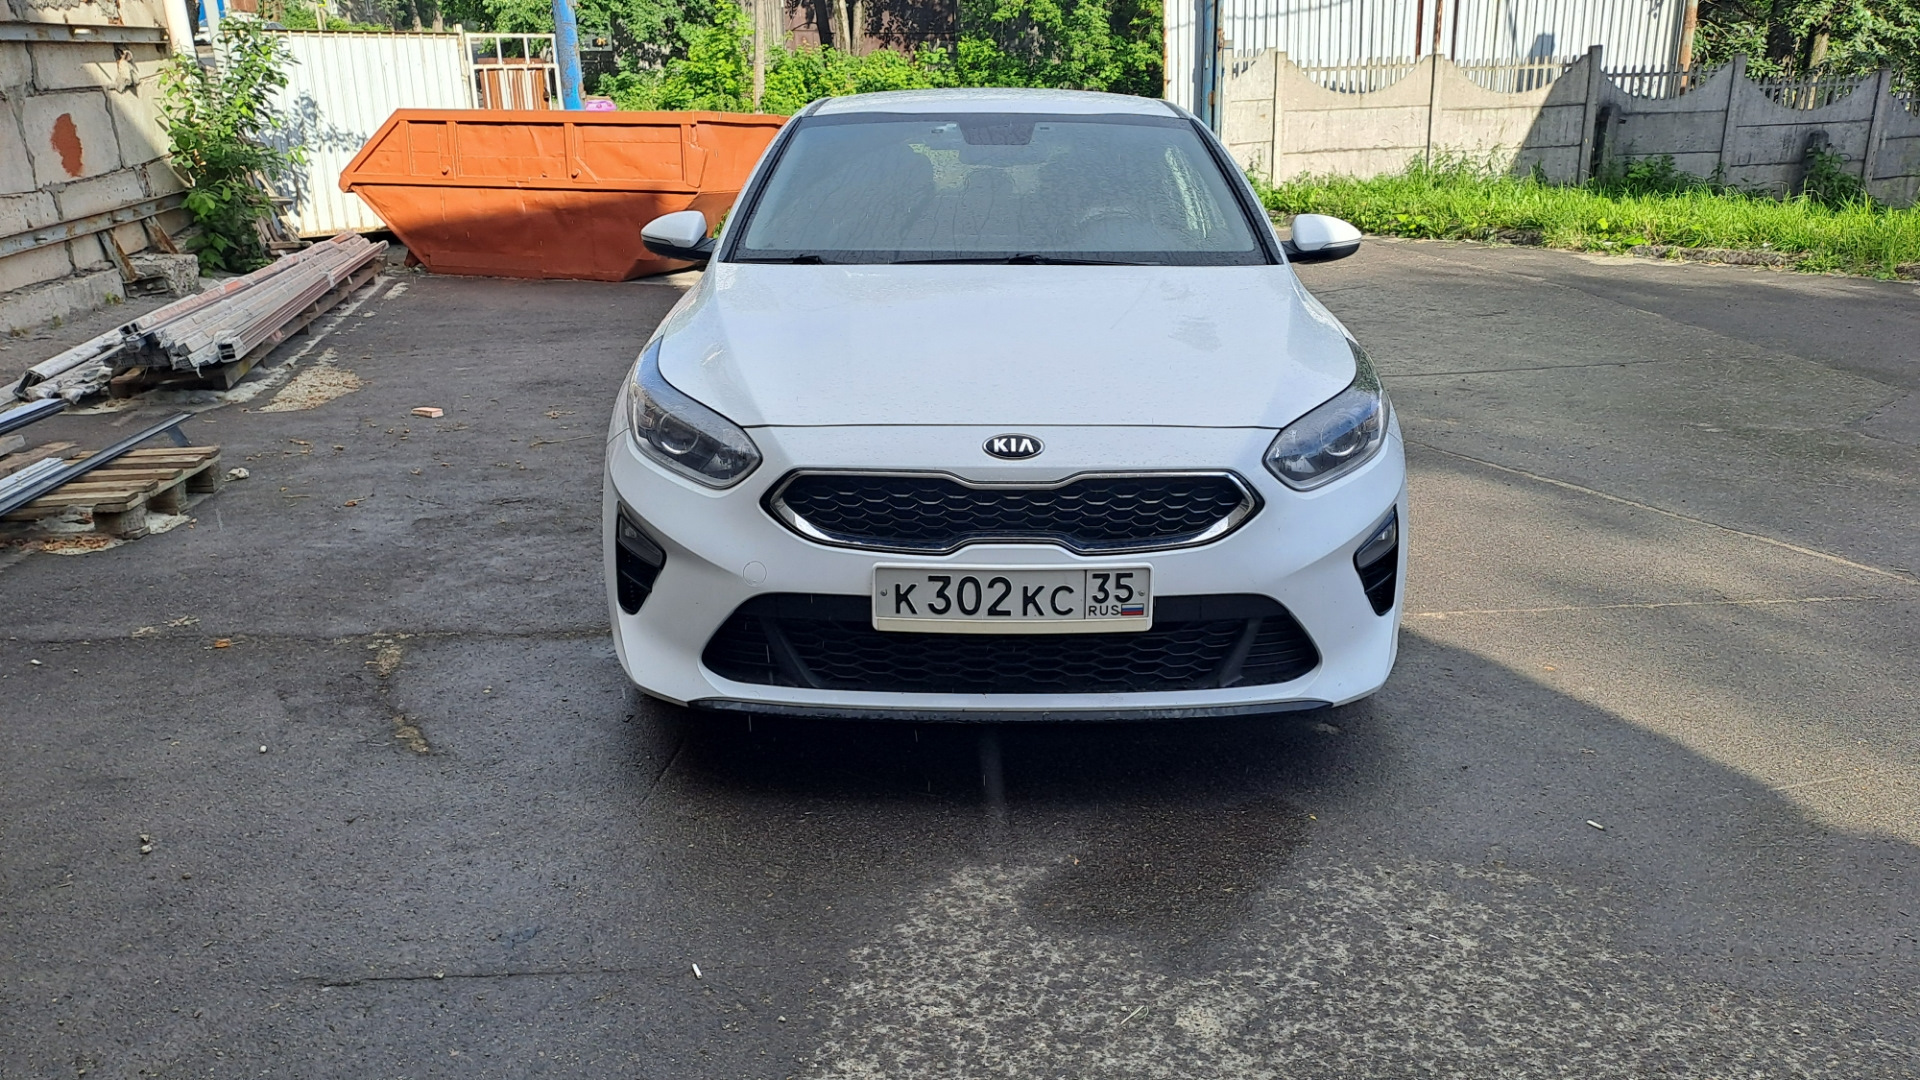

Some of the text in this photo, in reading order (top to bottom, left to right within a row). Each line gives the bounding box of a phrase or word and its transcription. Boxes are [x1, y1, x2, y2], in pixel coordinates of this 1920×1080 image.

[993, 437, 1034, 453] KIA
[1091, 572, 1134, 603] 35
[1088, 604, 1120, 616] RUS
